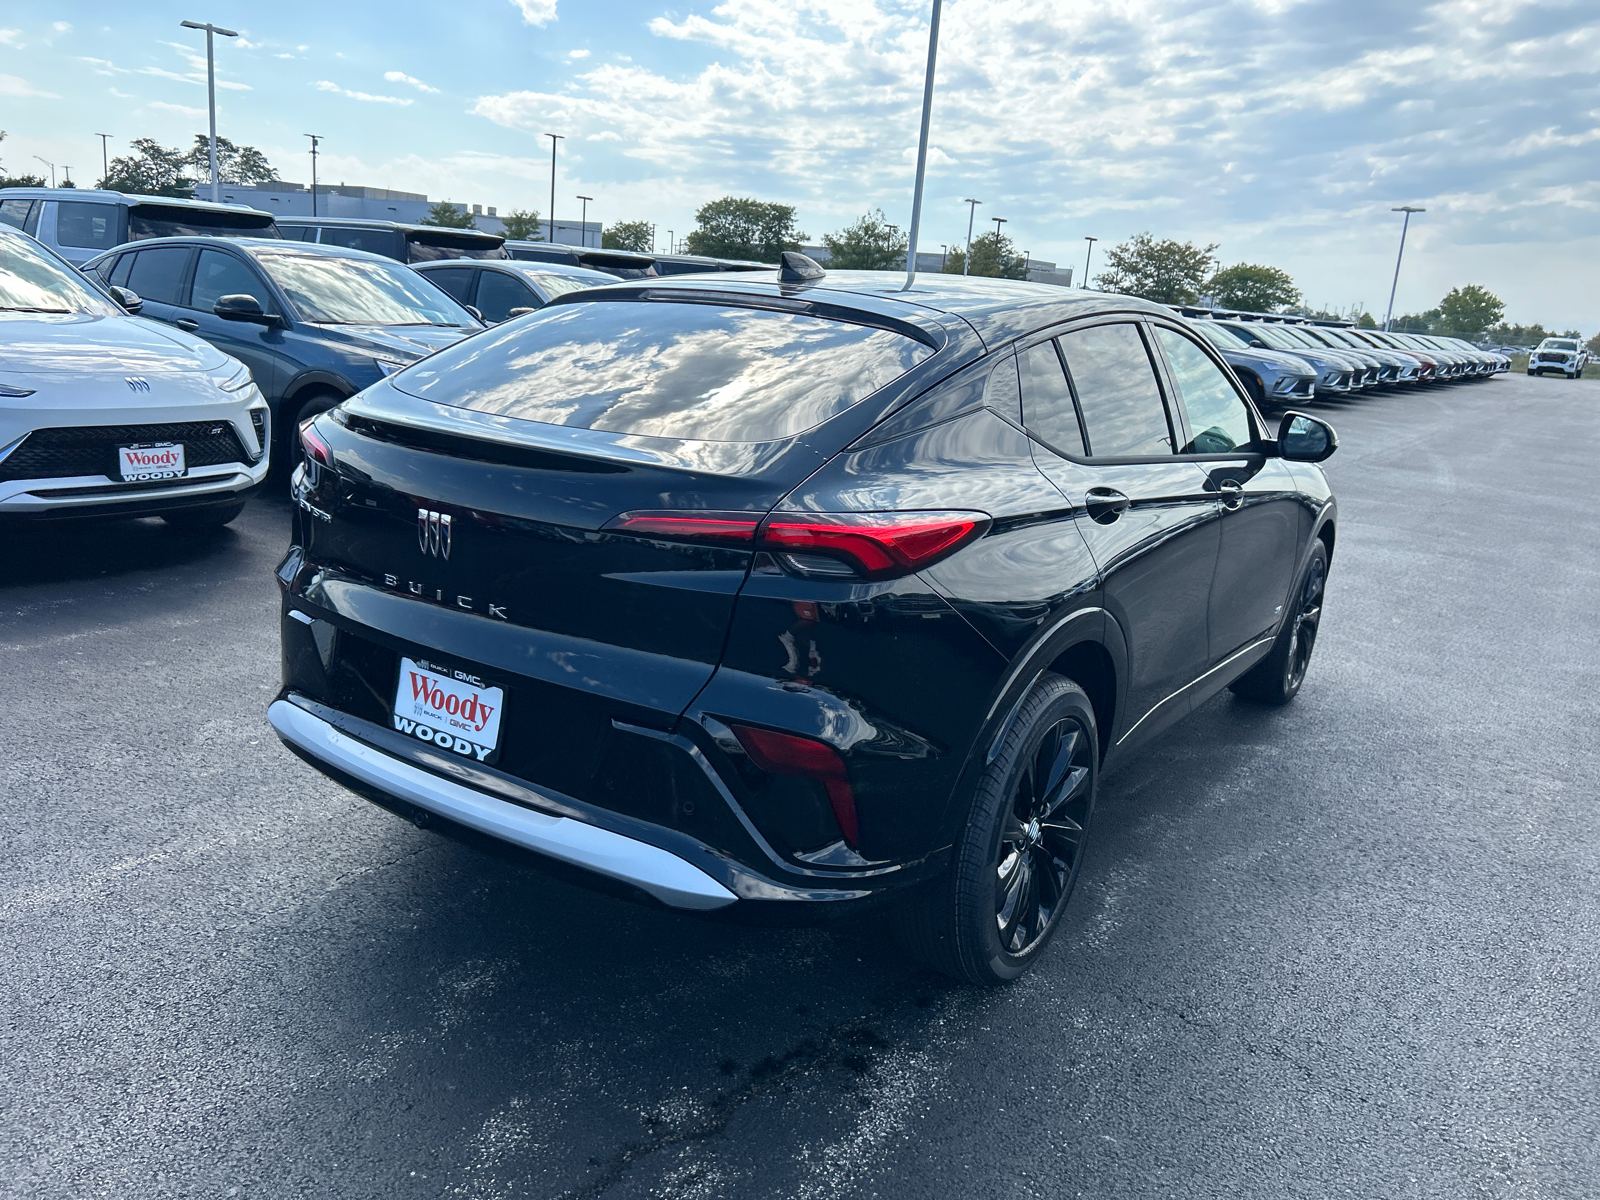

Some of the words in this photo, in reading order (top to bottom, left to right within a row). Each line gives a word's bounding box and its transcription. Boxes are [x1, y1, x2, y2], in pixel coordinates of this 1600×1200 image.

[124, 450, 180, 467] Woody
[123, 470, 185, 482] WOODY
[384, 573, 508, 620] BUICK
[430, 663, 449, 674] BUICK
[454, 670, 481, 686] GMC
[409, 671, 495, 732] Woody
[423, 710, 443, 721] BUICK
[449, 718, 472, 732] GMC
[393, 715, 492, 762] WOODY
